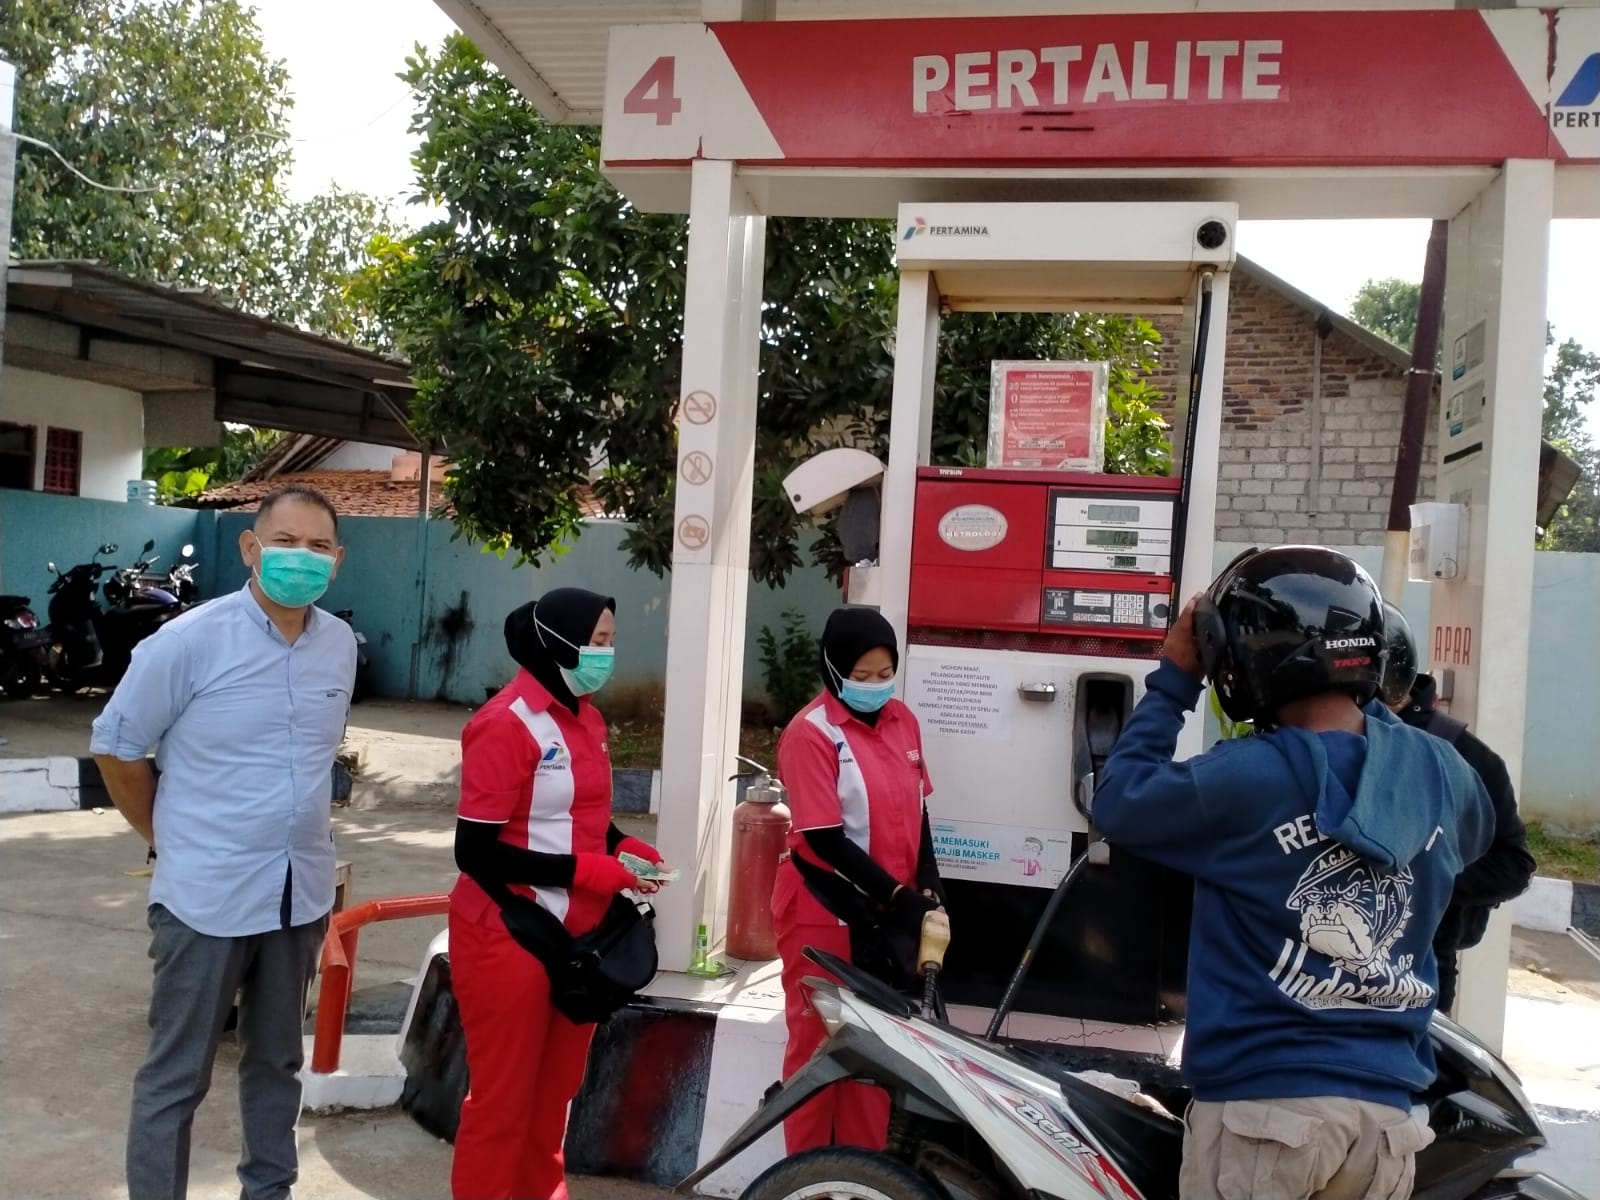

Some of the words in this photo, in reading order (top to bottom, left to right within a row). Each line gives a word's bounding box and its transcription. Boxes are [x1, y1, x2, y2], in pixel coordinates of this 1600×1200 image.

[913, 40, 1283, 114] PERTALITE
[623, 56, 681, 125] 4
[1553, 111, 1600, 128] PERT
[930, 226, 989, 236] PERTAMINA
[1324, 637, 1376, 650] HONDA
[1434, 626, 1472, 666] APAR
[940, 836, 989, 849] MEMASUKI
[932, 846, 961, 857] WAJIB
[962, 848, 1000, 861] MASKER
